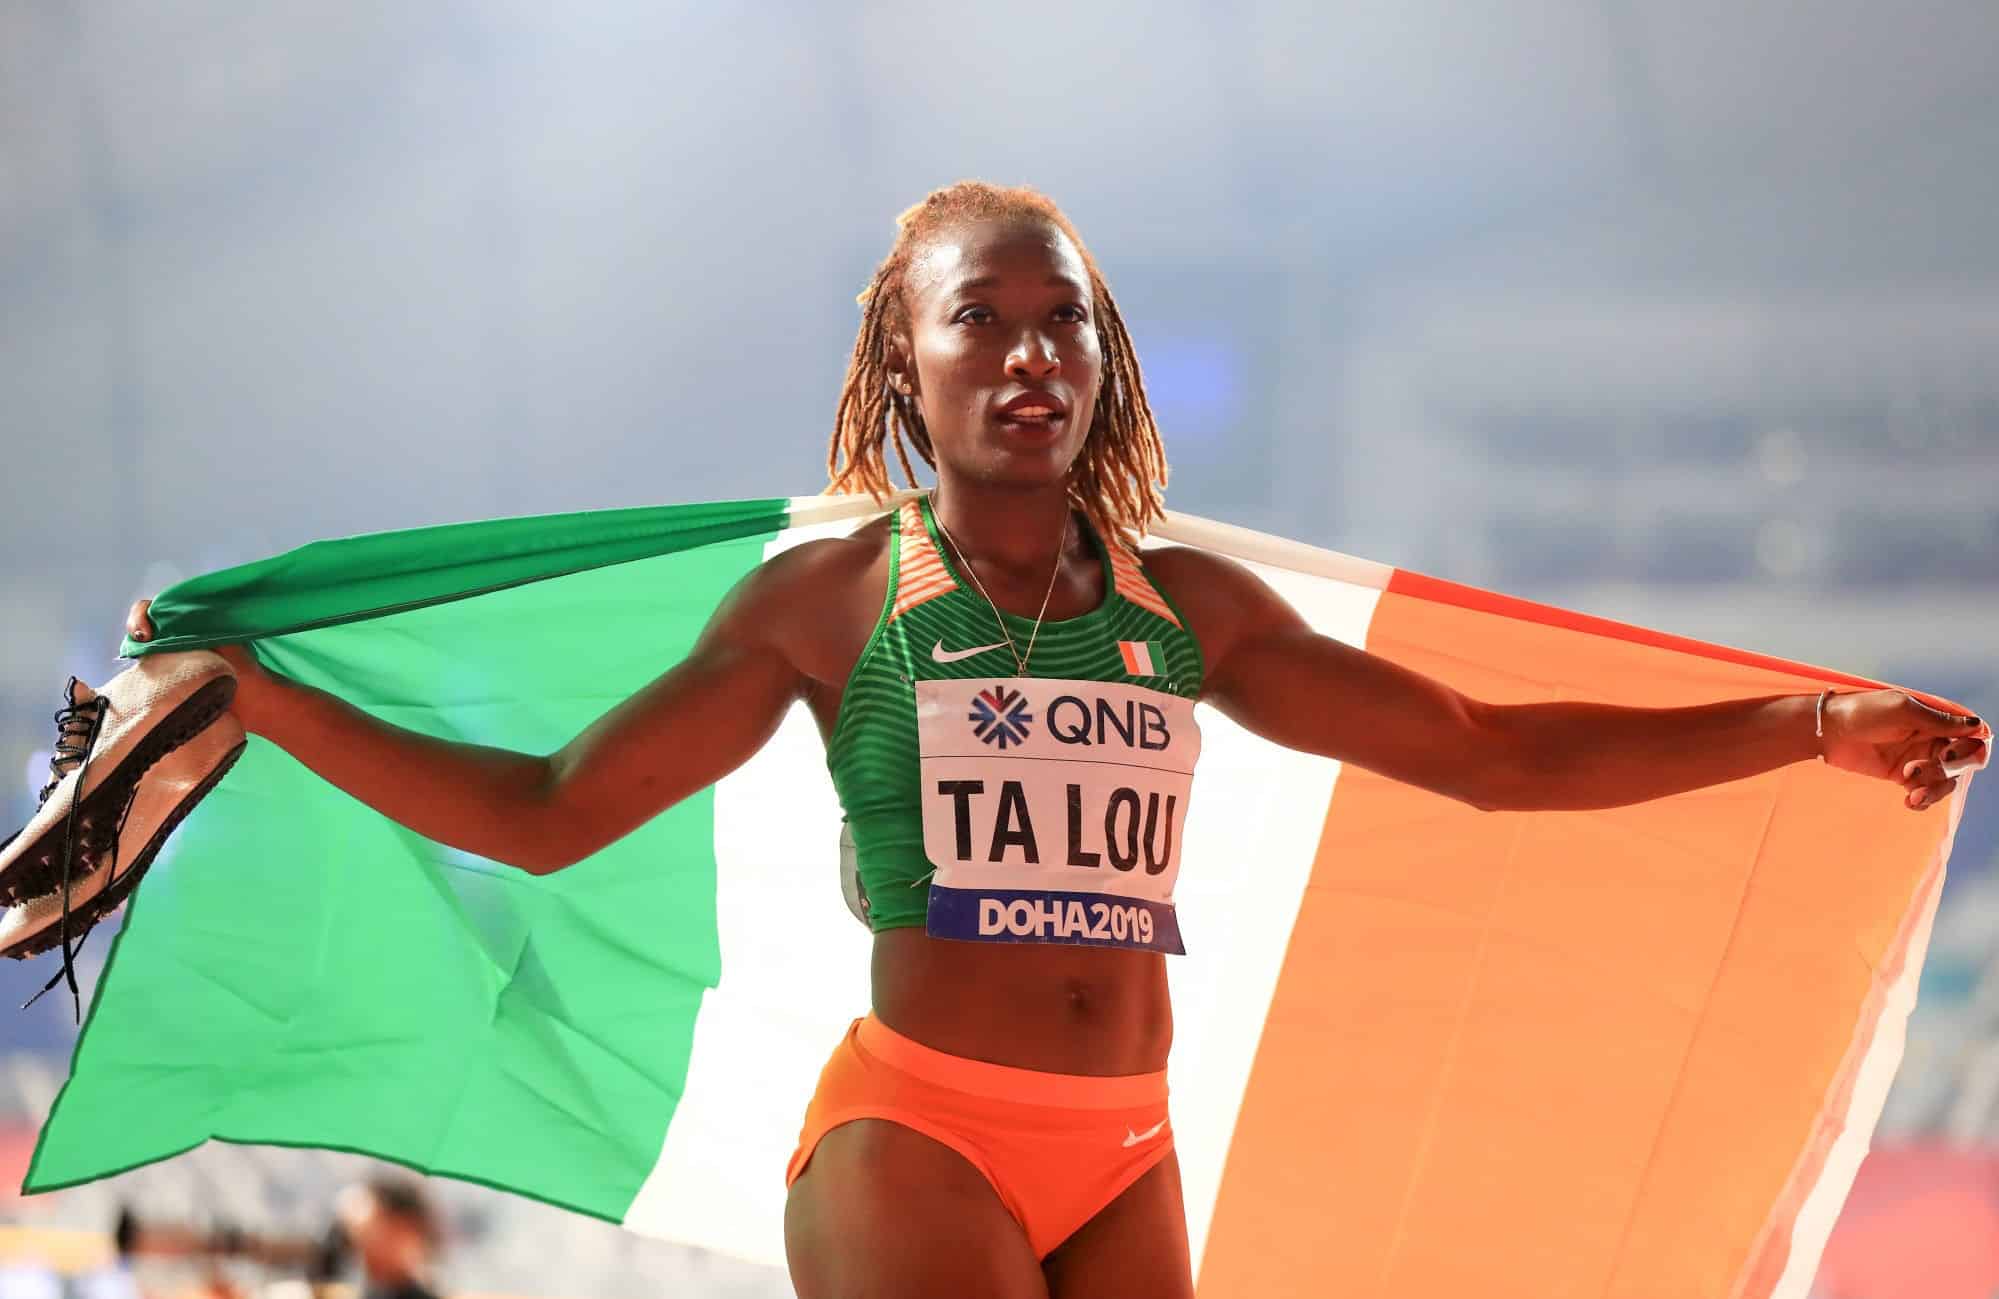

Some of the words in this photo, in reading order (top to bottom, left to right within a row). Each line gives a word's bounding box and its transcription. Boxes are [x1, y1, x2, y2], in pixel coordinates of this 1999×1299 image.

[1046, 695, 1171, 751] QNB
[937, 780, 1040, 864] TA
[1066, 783, 1177, 876] LOU
[978, 899, 1153, 944] DOHA2019
